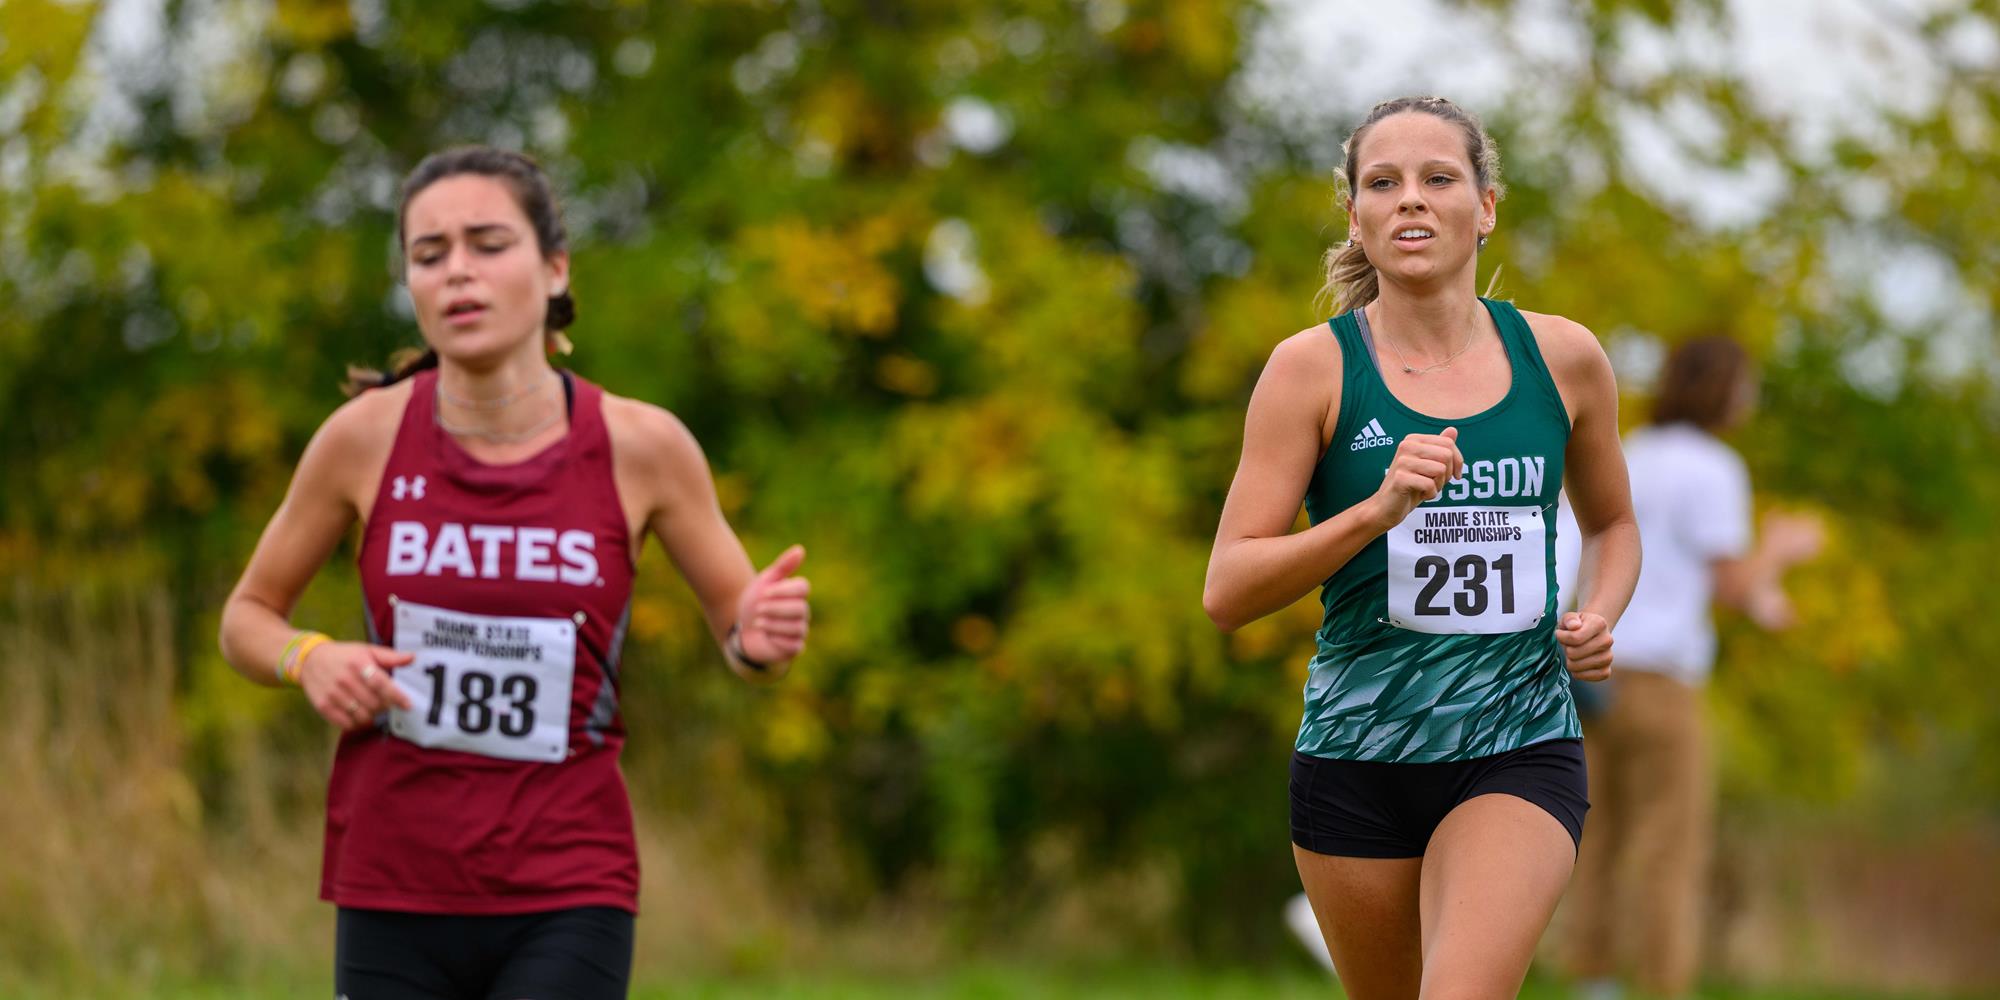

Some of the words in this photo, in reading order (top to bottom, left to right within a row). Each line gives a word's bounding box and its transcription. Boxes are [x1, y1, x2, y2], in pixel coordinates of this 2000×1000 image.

[1350, 435, 1394, 452] adidas
[1386, 456, 1545, 502] SSON
[1414, 526, 1521, 544] CHAMPIONSHIPS
[1425, 512, 1469, 528] MAINE
[1472, 511, 1509, 527] STATE
[1414, 554, 1515, 616] 231
[424, 662, 537, 737] 183
